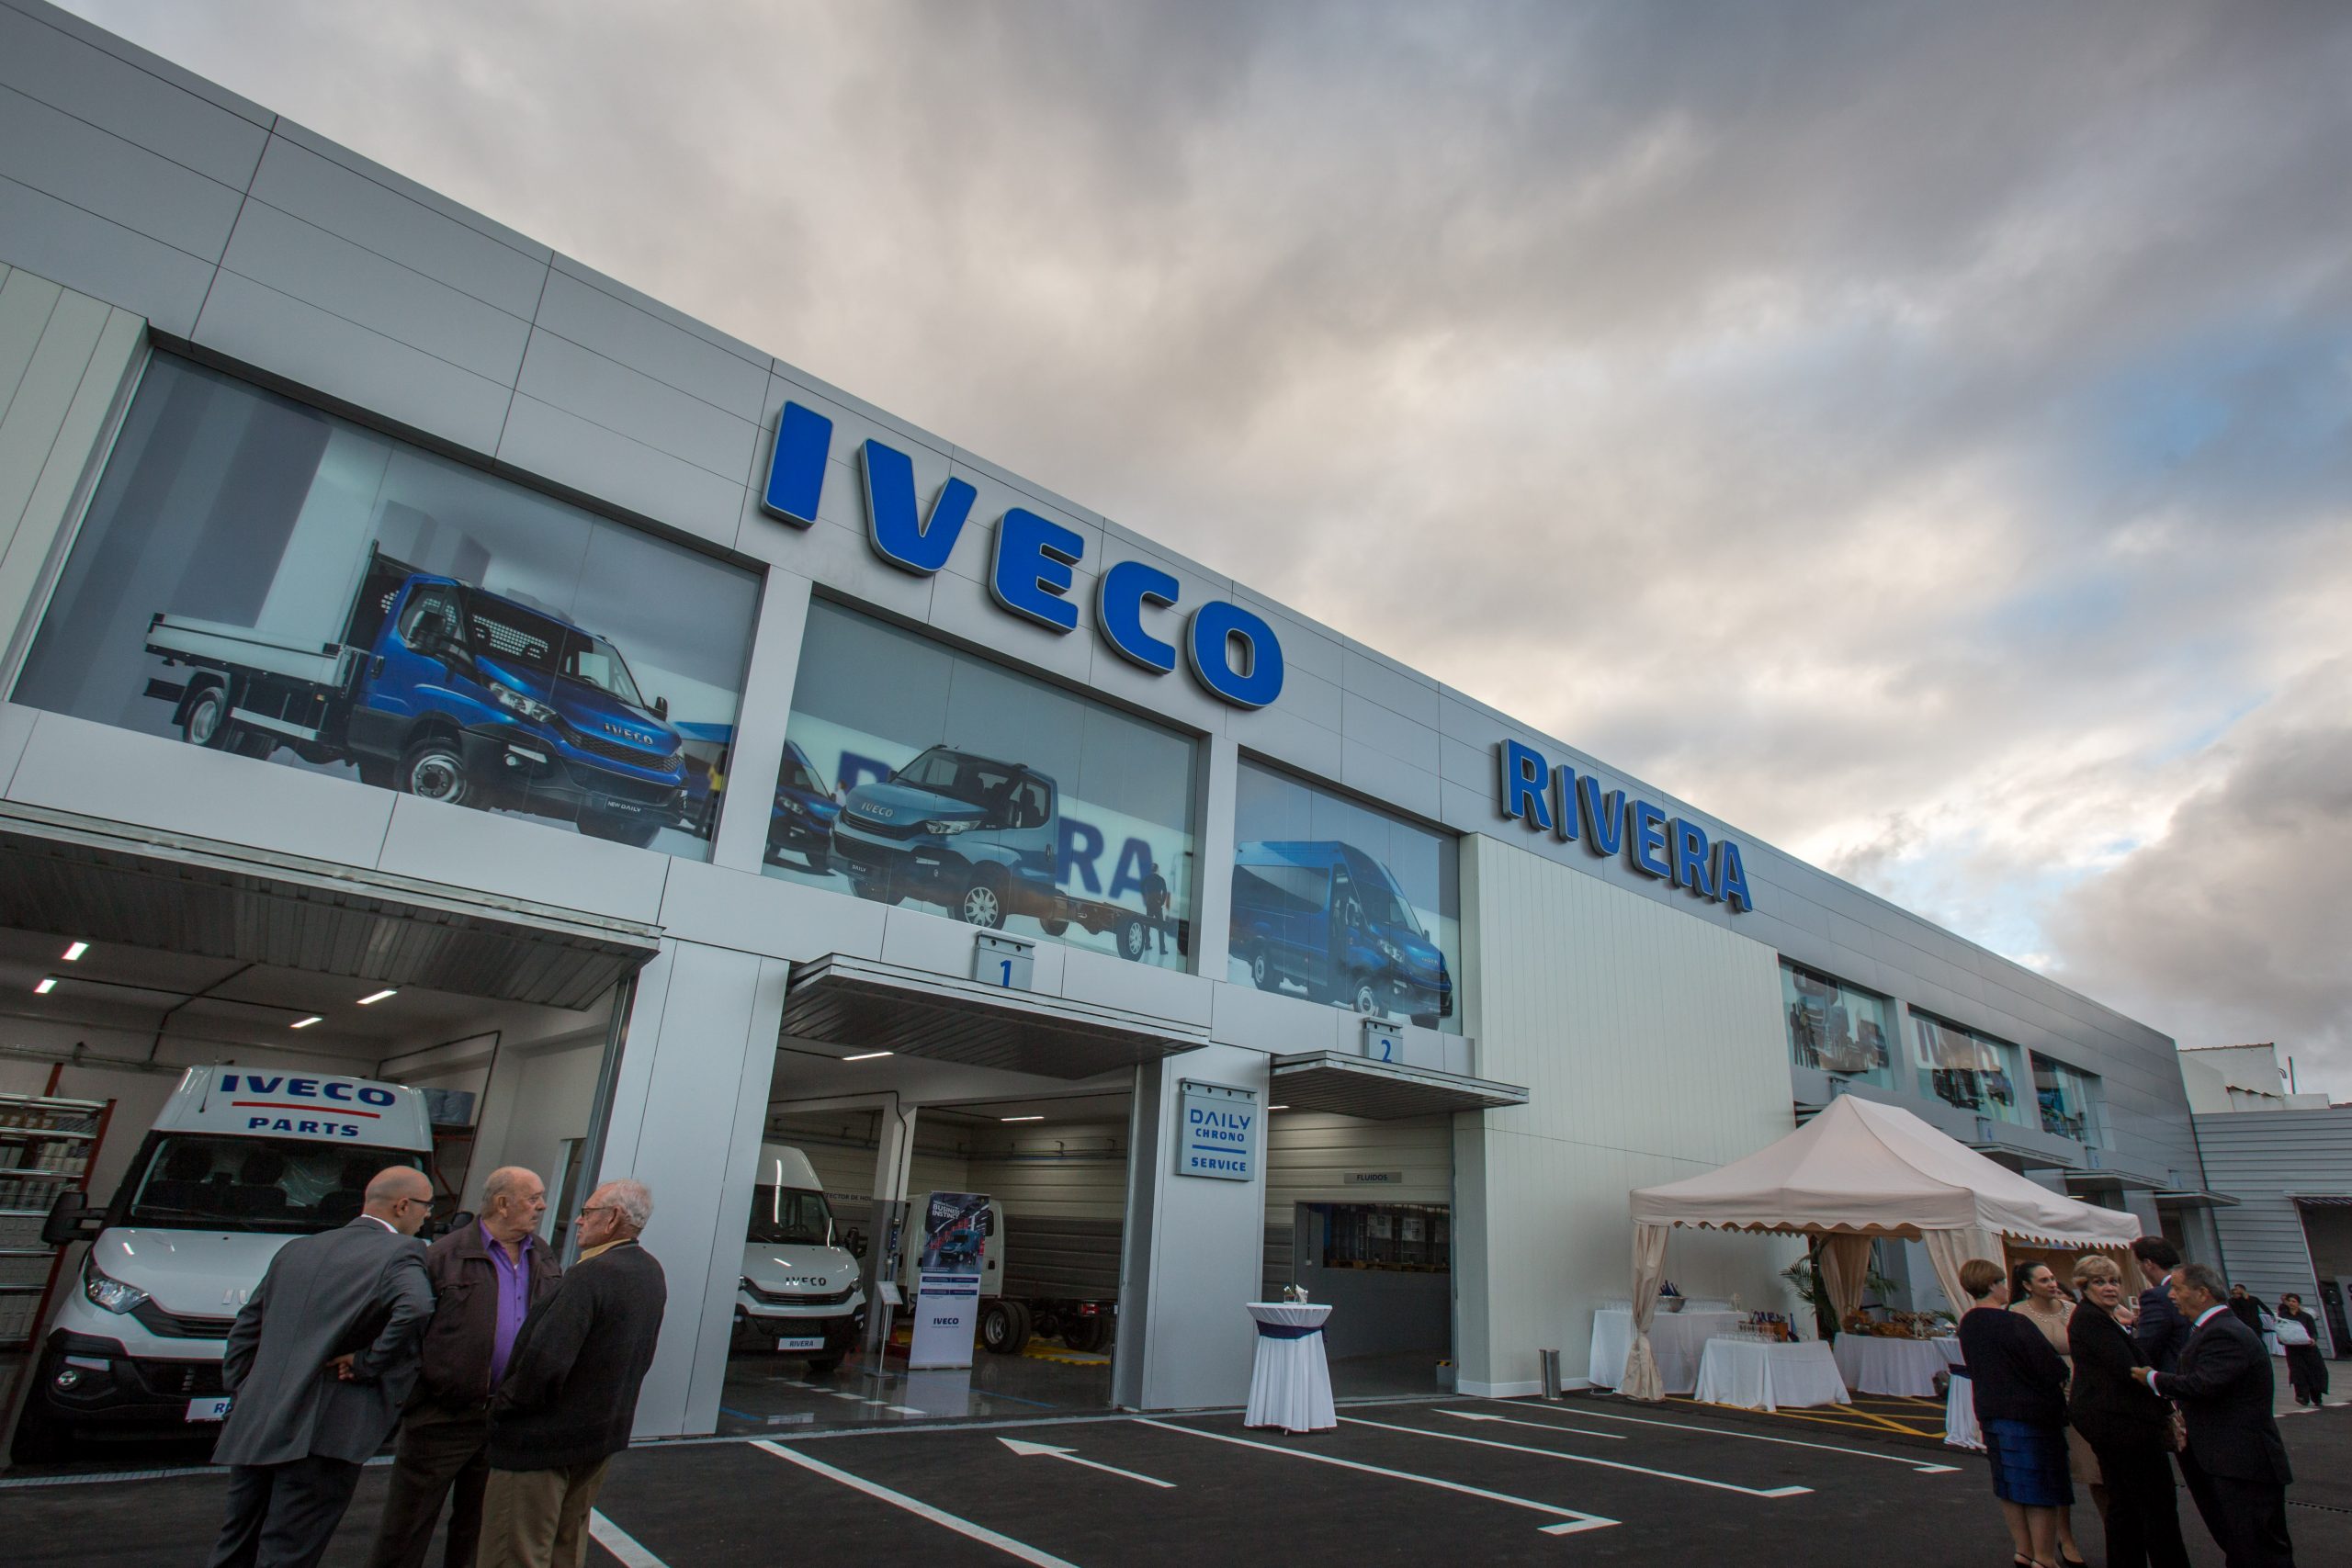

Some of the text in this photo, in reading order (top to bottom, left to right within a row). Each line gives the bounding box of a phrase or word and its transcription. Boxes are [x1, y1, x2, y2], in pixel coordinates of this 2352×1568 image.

[761, 400, 1283, 711] IVECO
[604, 722, 653, 746] IVECO
[621, 804, 641, 812] DAILY
[861, 802, 894, 818] IVECO
[1500, 739, 1753, 912] RIVERA
[852, 864, 866, 873] DAILY
[1001, 960, 1012, 987] 1
[1381, 1039, 1392, 1063] 2
[220, 1075, 396, 1106] IVECO
[248, 1117, 359, 1137] PARTS
[1190, 1108, 1250, 1130] DAILY
[1195, 1128, 1244, 1142] CHRONO
[1192, 1156, 1246, 1171] SERVICE
[932, 1210, 959, 1220] INSTINCT
[933, 1203, 960, 1215] BUSINESS
[786, 1277, 827, 1286] IVECO
[789, 1339, 814, 1348] RIVERA
